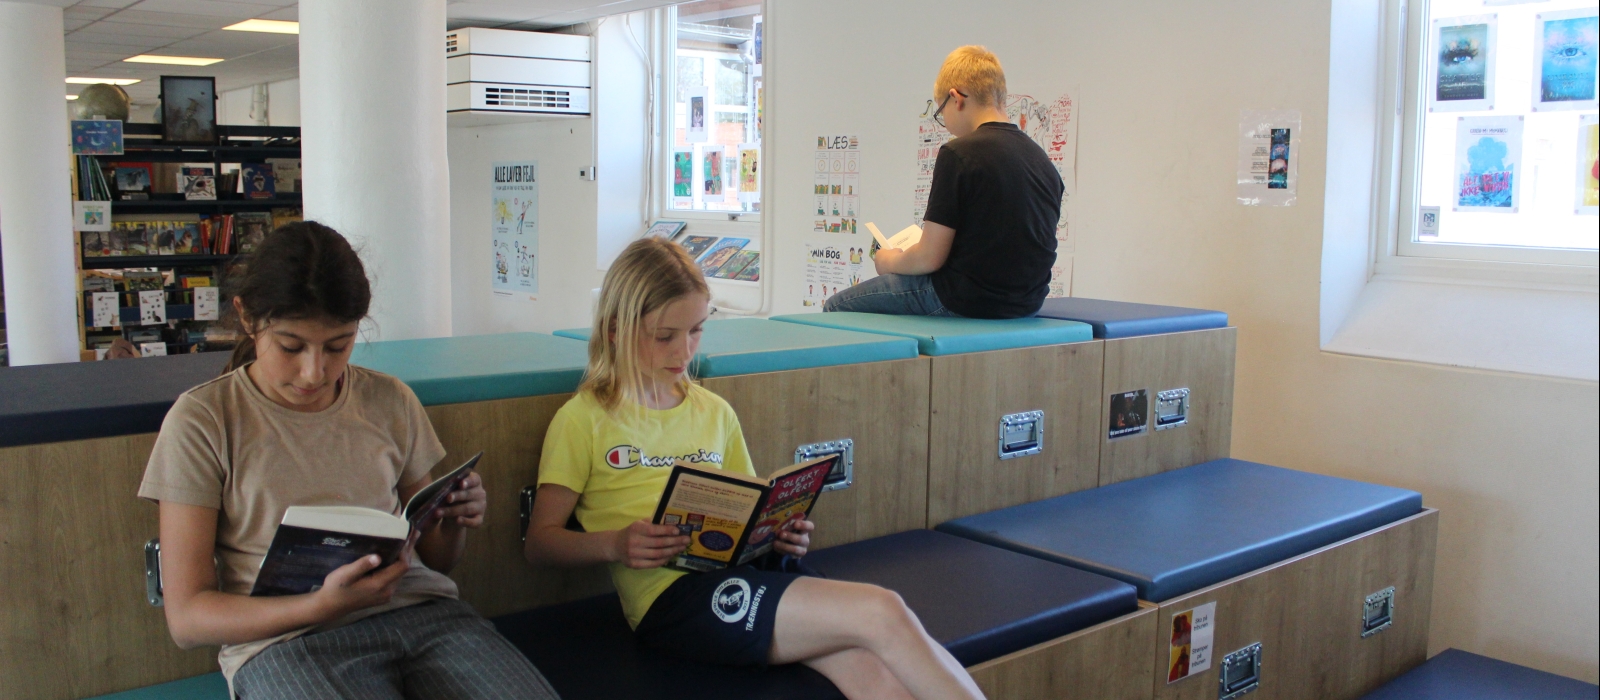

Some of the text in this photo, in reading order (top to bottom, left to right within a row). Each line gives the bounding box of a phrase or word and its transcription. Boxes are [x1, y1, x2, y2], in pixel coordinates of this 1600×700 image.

[827, 135, 848, 150] LÆS
[495, 165, 536, 183] ALLE LAVER FEJL
[811, 249, 841, 260] MIN BOG
[782, 469, 820, 489] OLFERT
[778, 481, 814, 499] OLFERT
[745, 584, 767, 632] TRÆNINGSTØJ
[1202, 614, 1208, 623] på
[1193, 622, 1209, 632] tribunen
[1196, 652, 1202, 660] på
[1191, 658, 1206, 668] tribunen
